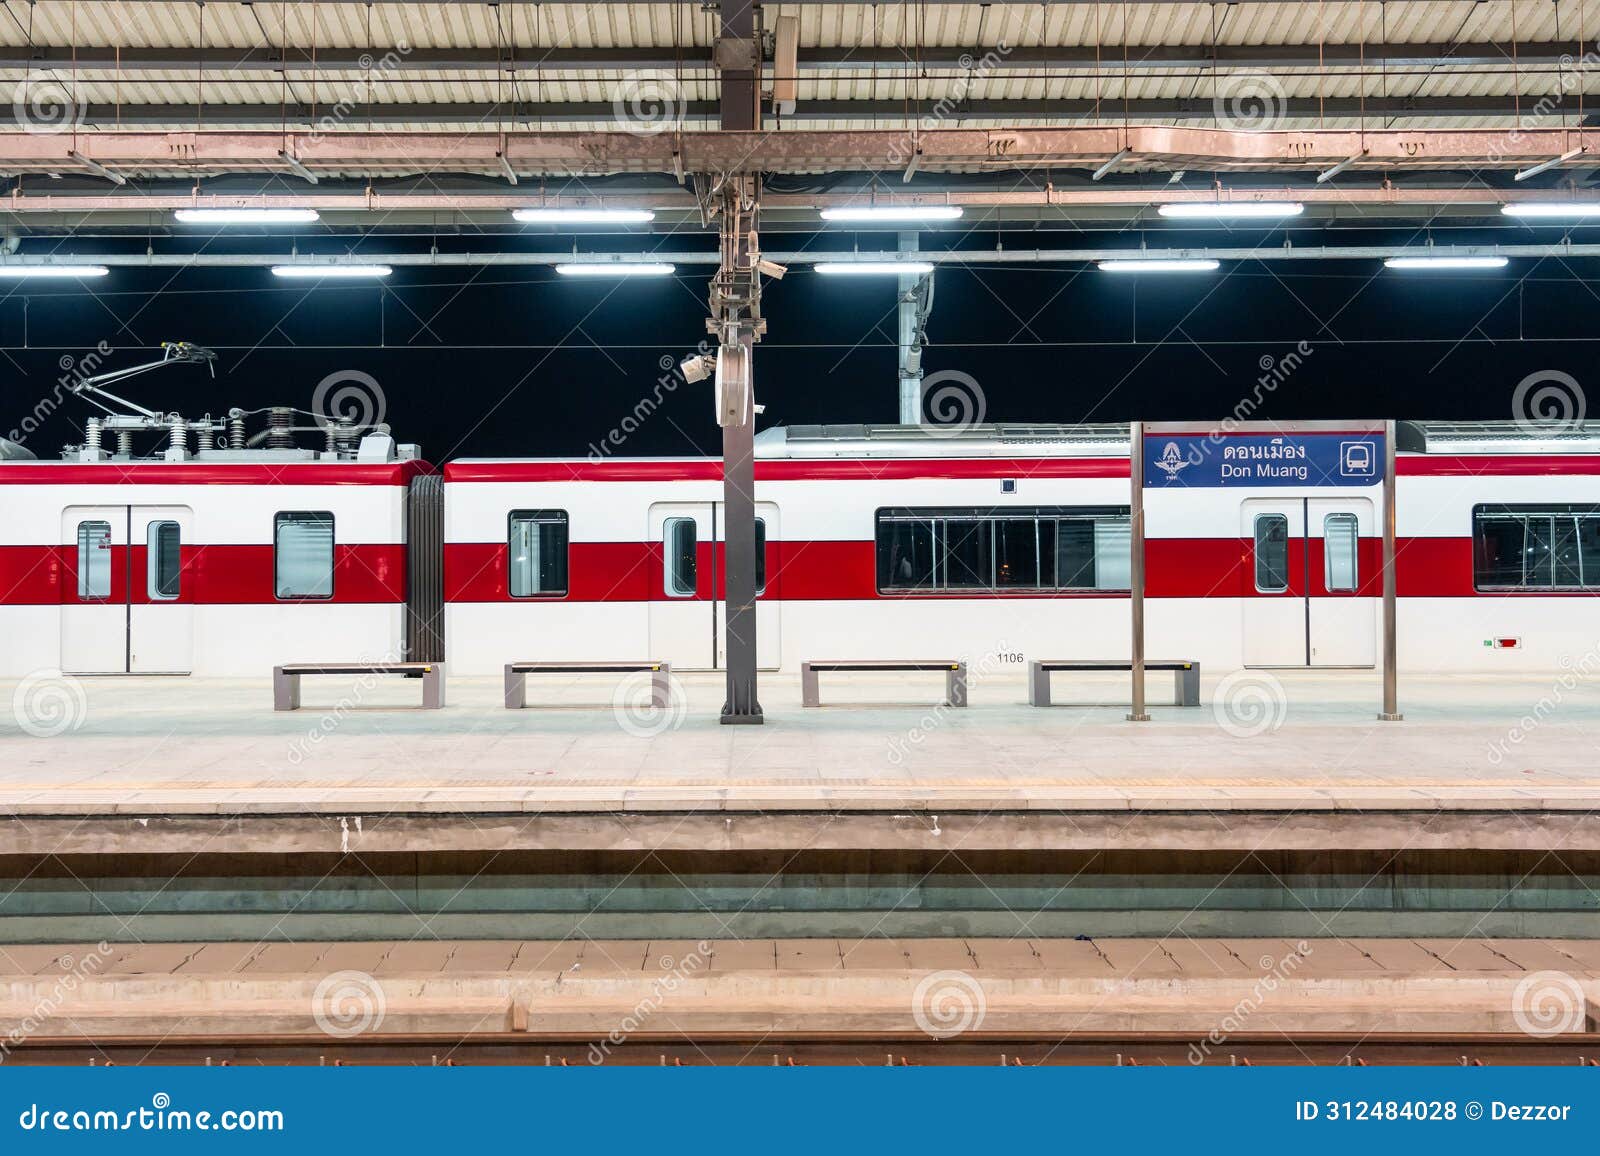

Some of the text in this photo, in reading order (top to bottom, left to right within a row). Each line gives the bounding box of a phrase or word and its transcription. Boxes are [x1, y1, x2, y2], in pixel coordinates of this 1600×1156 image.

[1224, 438, 1305, 460] ดอนเมือง
[1221, 464, 1308, 480] Don Muang
[997, 652, 1024, 664] 1106
